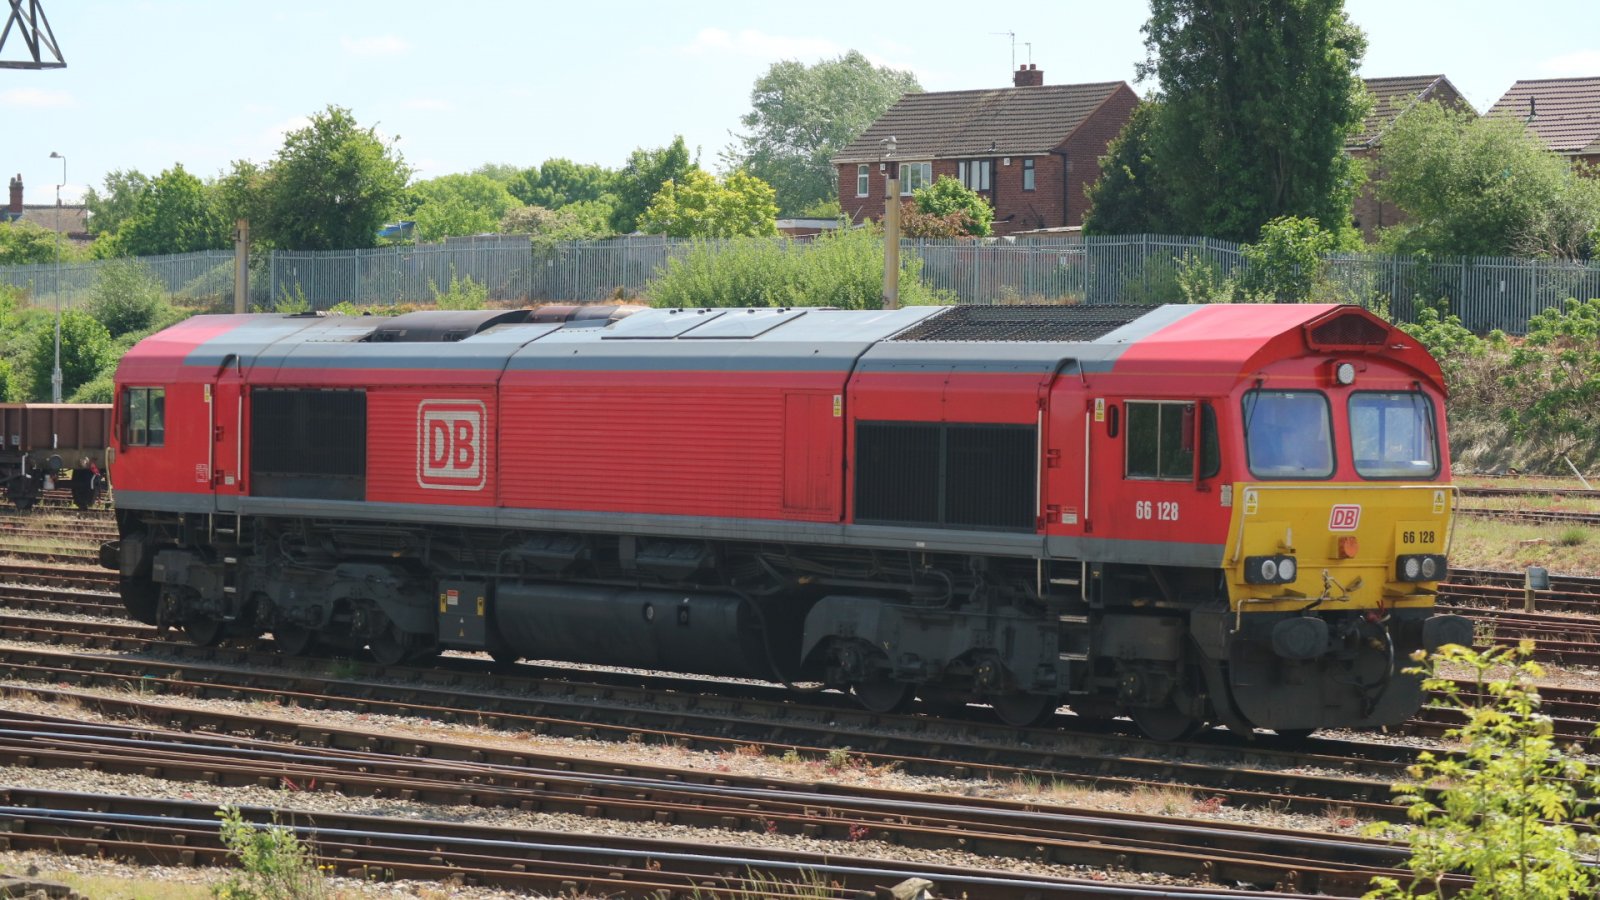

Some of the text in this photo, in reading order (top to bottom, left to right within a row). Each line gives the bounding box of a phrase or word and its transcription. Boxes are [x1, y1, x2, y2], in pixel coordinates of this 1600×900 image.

[429, 419, 475, 470] DB
[1136, 500, 1179, 521] 66 128
[1333, 509, 1355, 526] DB
[1403, 531, 1435, 544] 66 128
